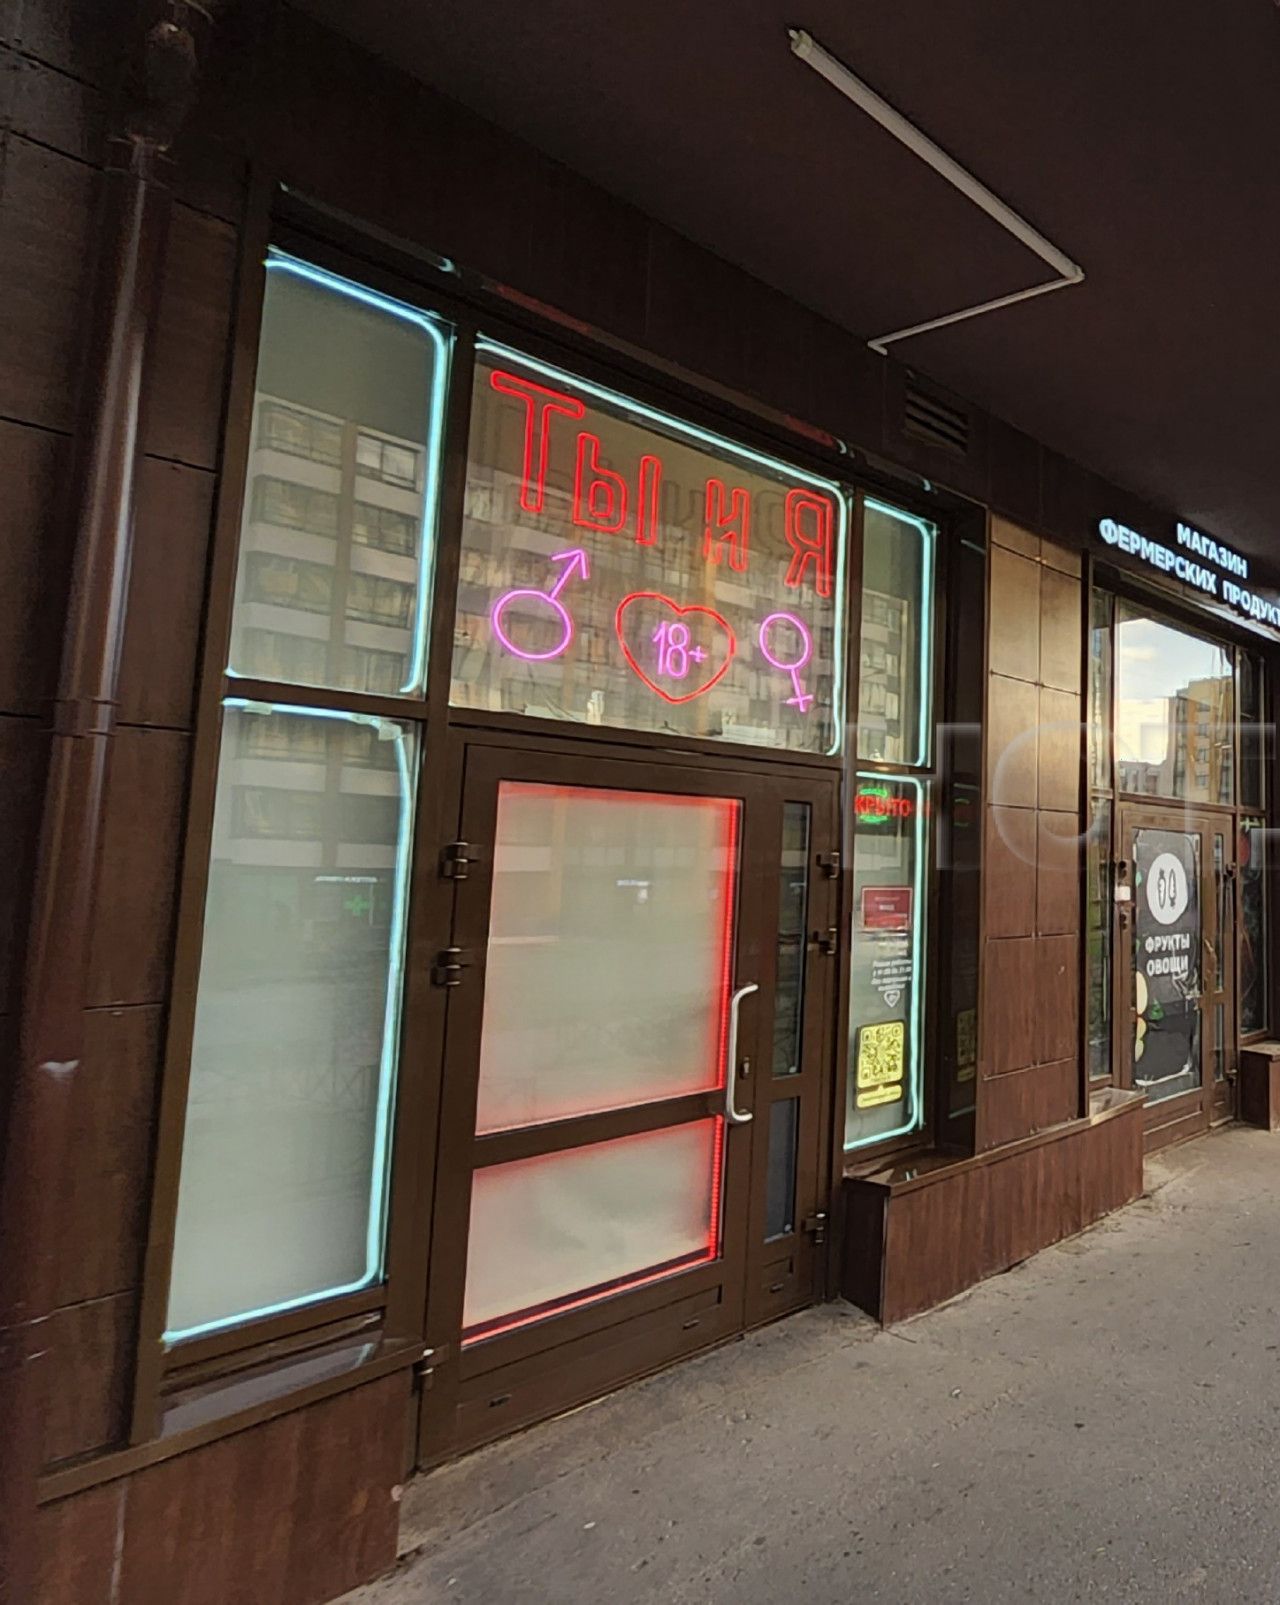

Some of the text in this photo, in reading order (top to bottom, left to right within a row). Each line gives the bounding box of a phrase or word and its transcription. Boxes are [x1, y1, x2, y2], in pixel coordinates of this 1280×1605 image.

[490, 370, 662, 547] Ты
[784, 489, 833, 598] Я
[1099, 518, 1218, 595] ФЕРМЕРСКИХ
[1177, 522, 1249, 579] МАГАЗИН
[652, 621, 708, 680] 18+
[1145, 933, 1190, 953] ФРУКТЫ
[1146, 955, 1189, 976] ОВОЩИ
